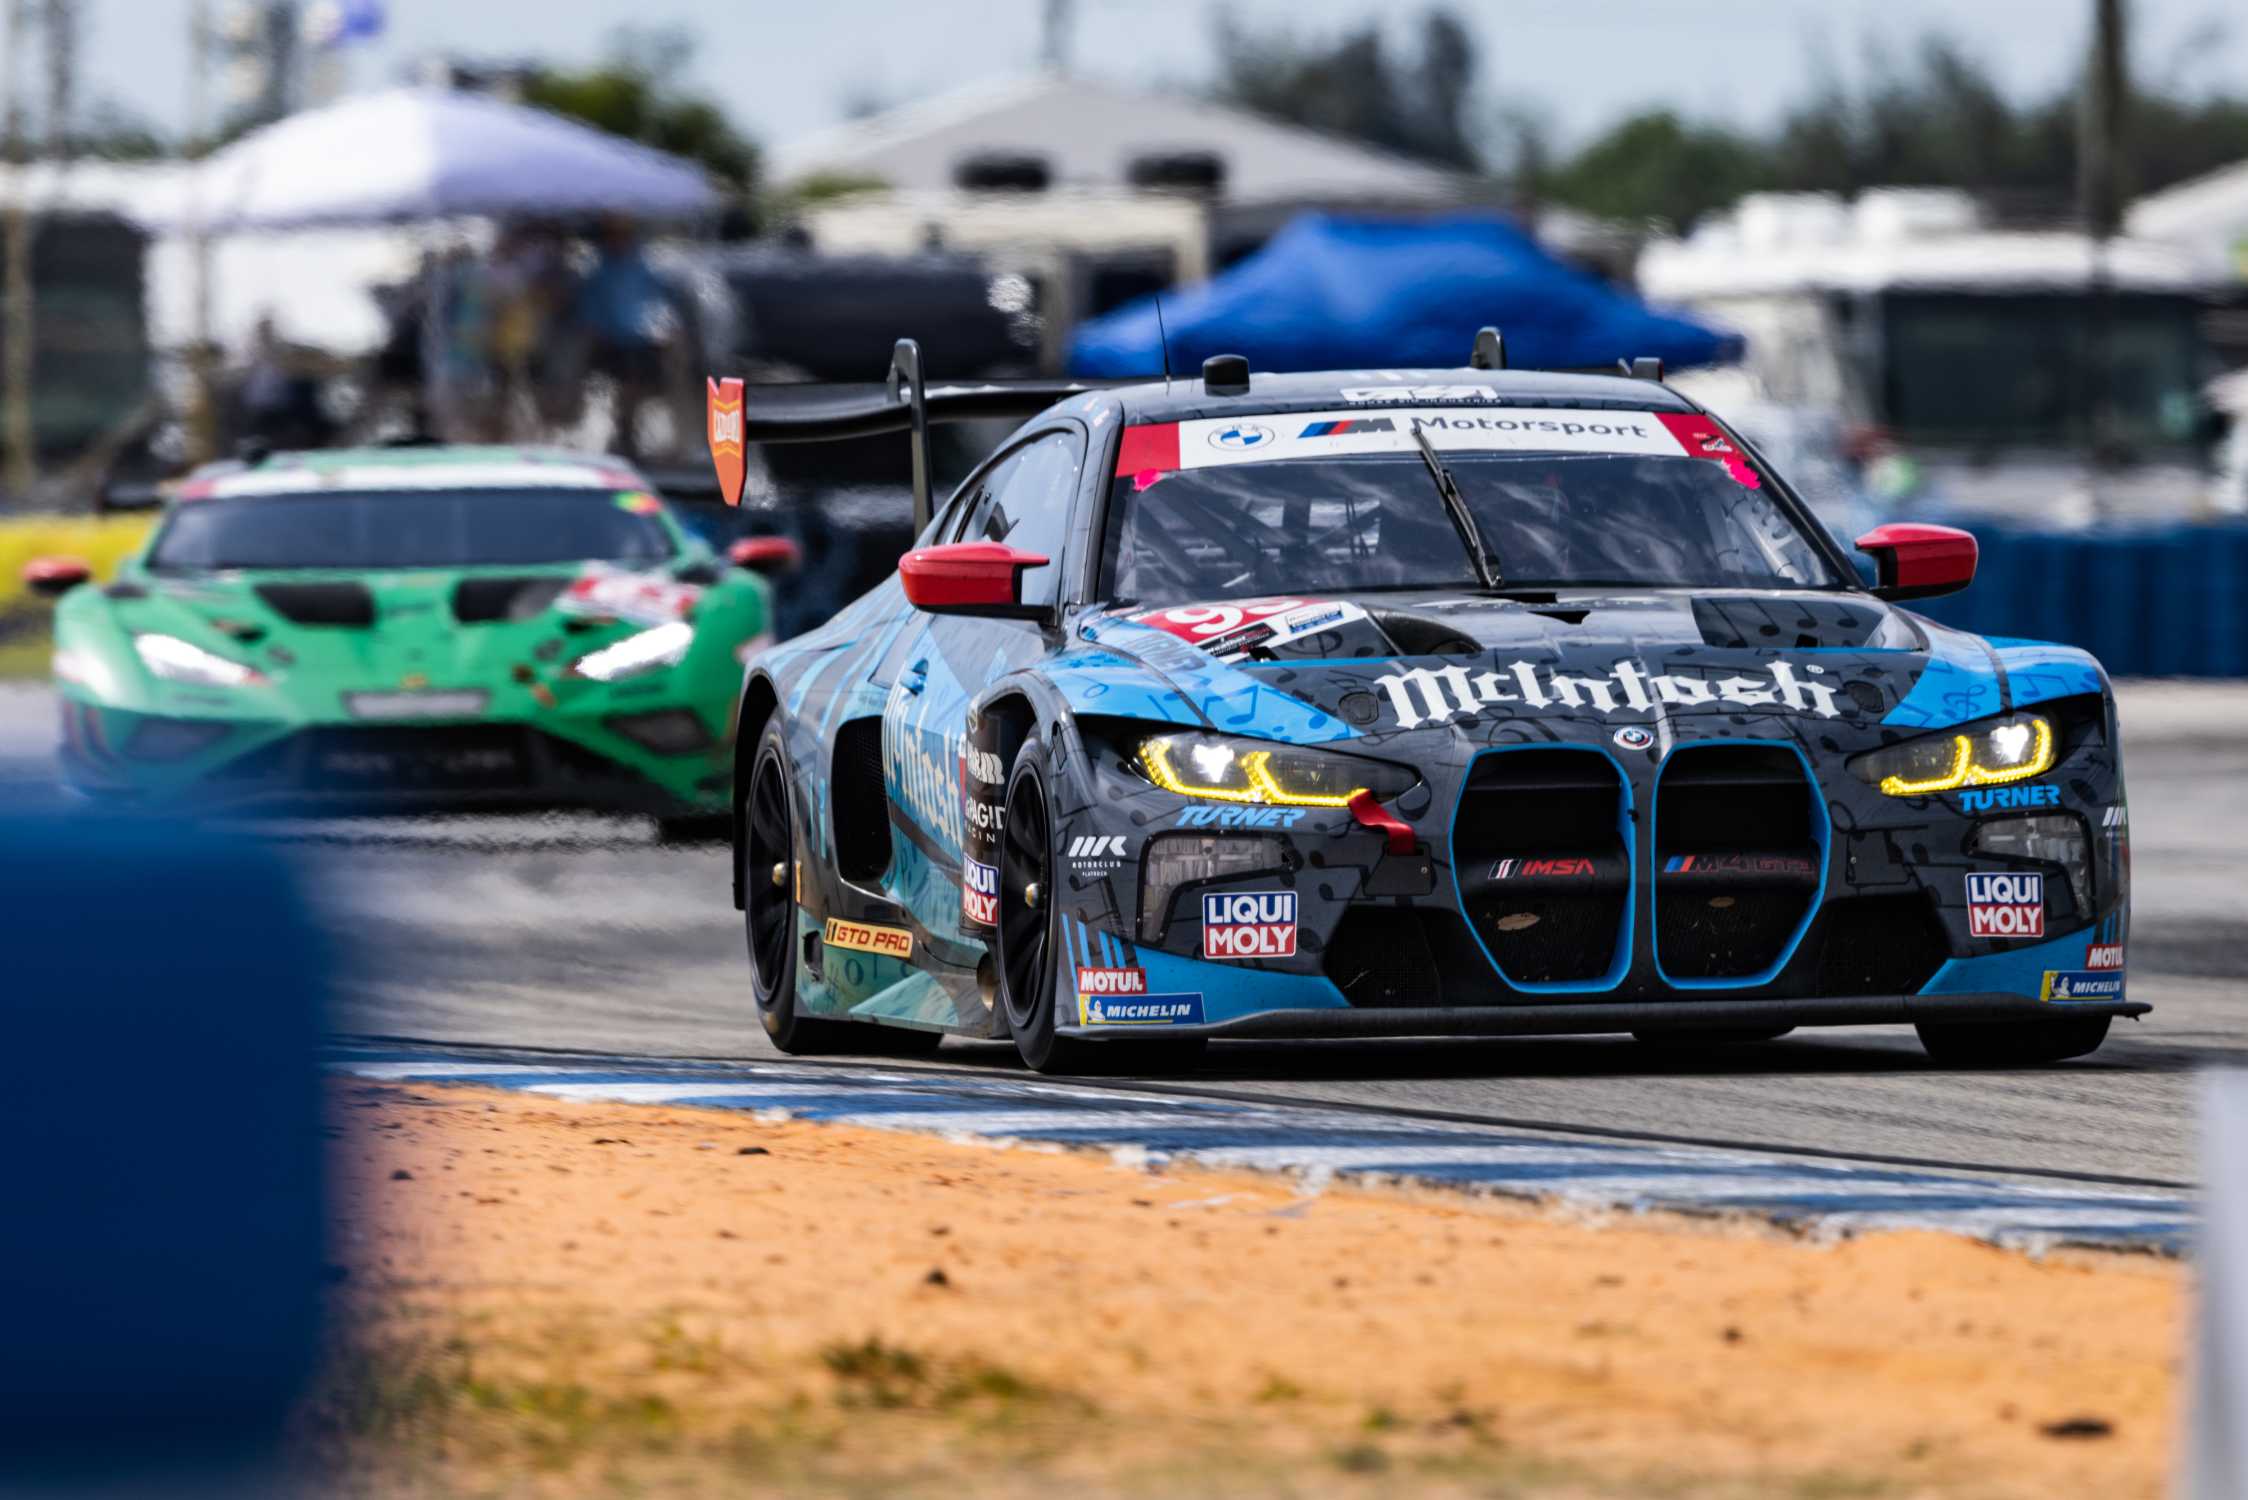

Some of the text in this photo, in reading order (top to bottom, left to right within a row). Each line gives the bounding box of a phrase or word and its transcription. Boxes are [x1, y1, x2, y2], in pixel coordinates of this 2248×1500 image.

[1410, 416, 1649, 438] Motorsport
[1374, 660, 1842, 730] McIntosh
[1958, 784, 2061, 813] TURNER
[1176, 805, 1307, 828] TURNER
[1521, 858, 1596, 876] IMSA
[1970, 876, 2039, 905] LIQUI
[1208, 894, 1293, 925] LIQUI
[1973, 906, 2042, 935] MOLY
[836, 923, 911, 952] GTD PRO
[1208, 925, 1296, 955] MOLY
[1080, 970, 1144, 993] MOTUL
[1106, 1003, 1192, 1017] MICHELIN
